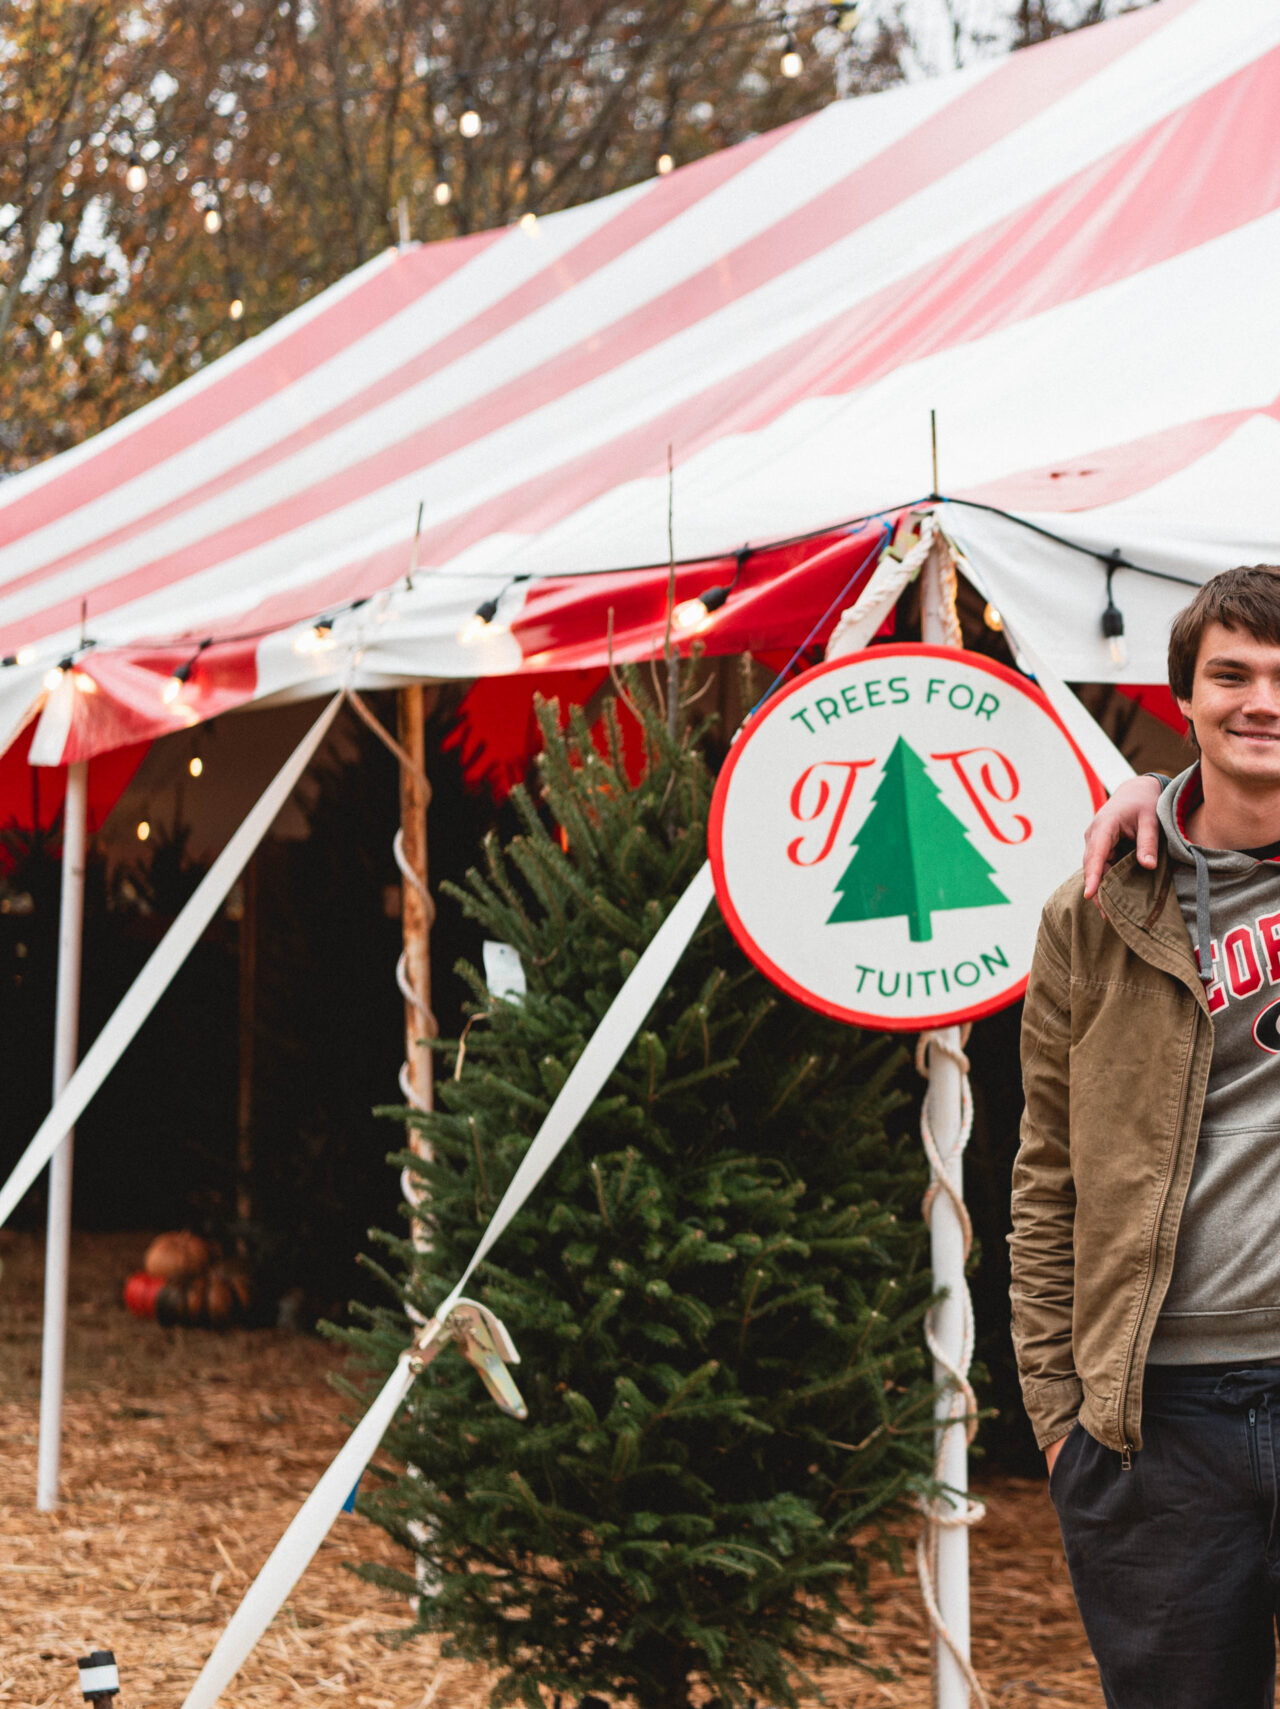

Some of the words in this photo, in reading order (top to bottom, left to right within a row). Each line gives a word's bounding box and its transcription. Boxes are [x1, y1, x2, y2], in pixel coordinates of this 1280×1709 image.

[790, 676, 910, 734] TREES
[926, 678, 1000, 721] FOR
[854, 945, 1010, 998] TUITION
